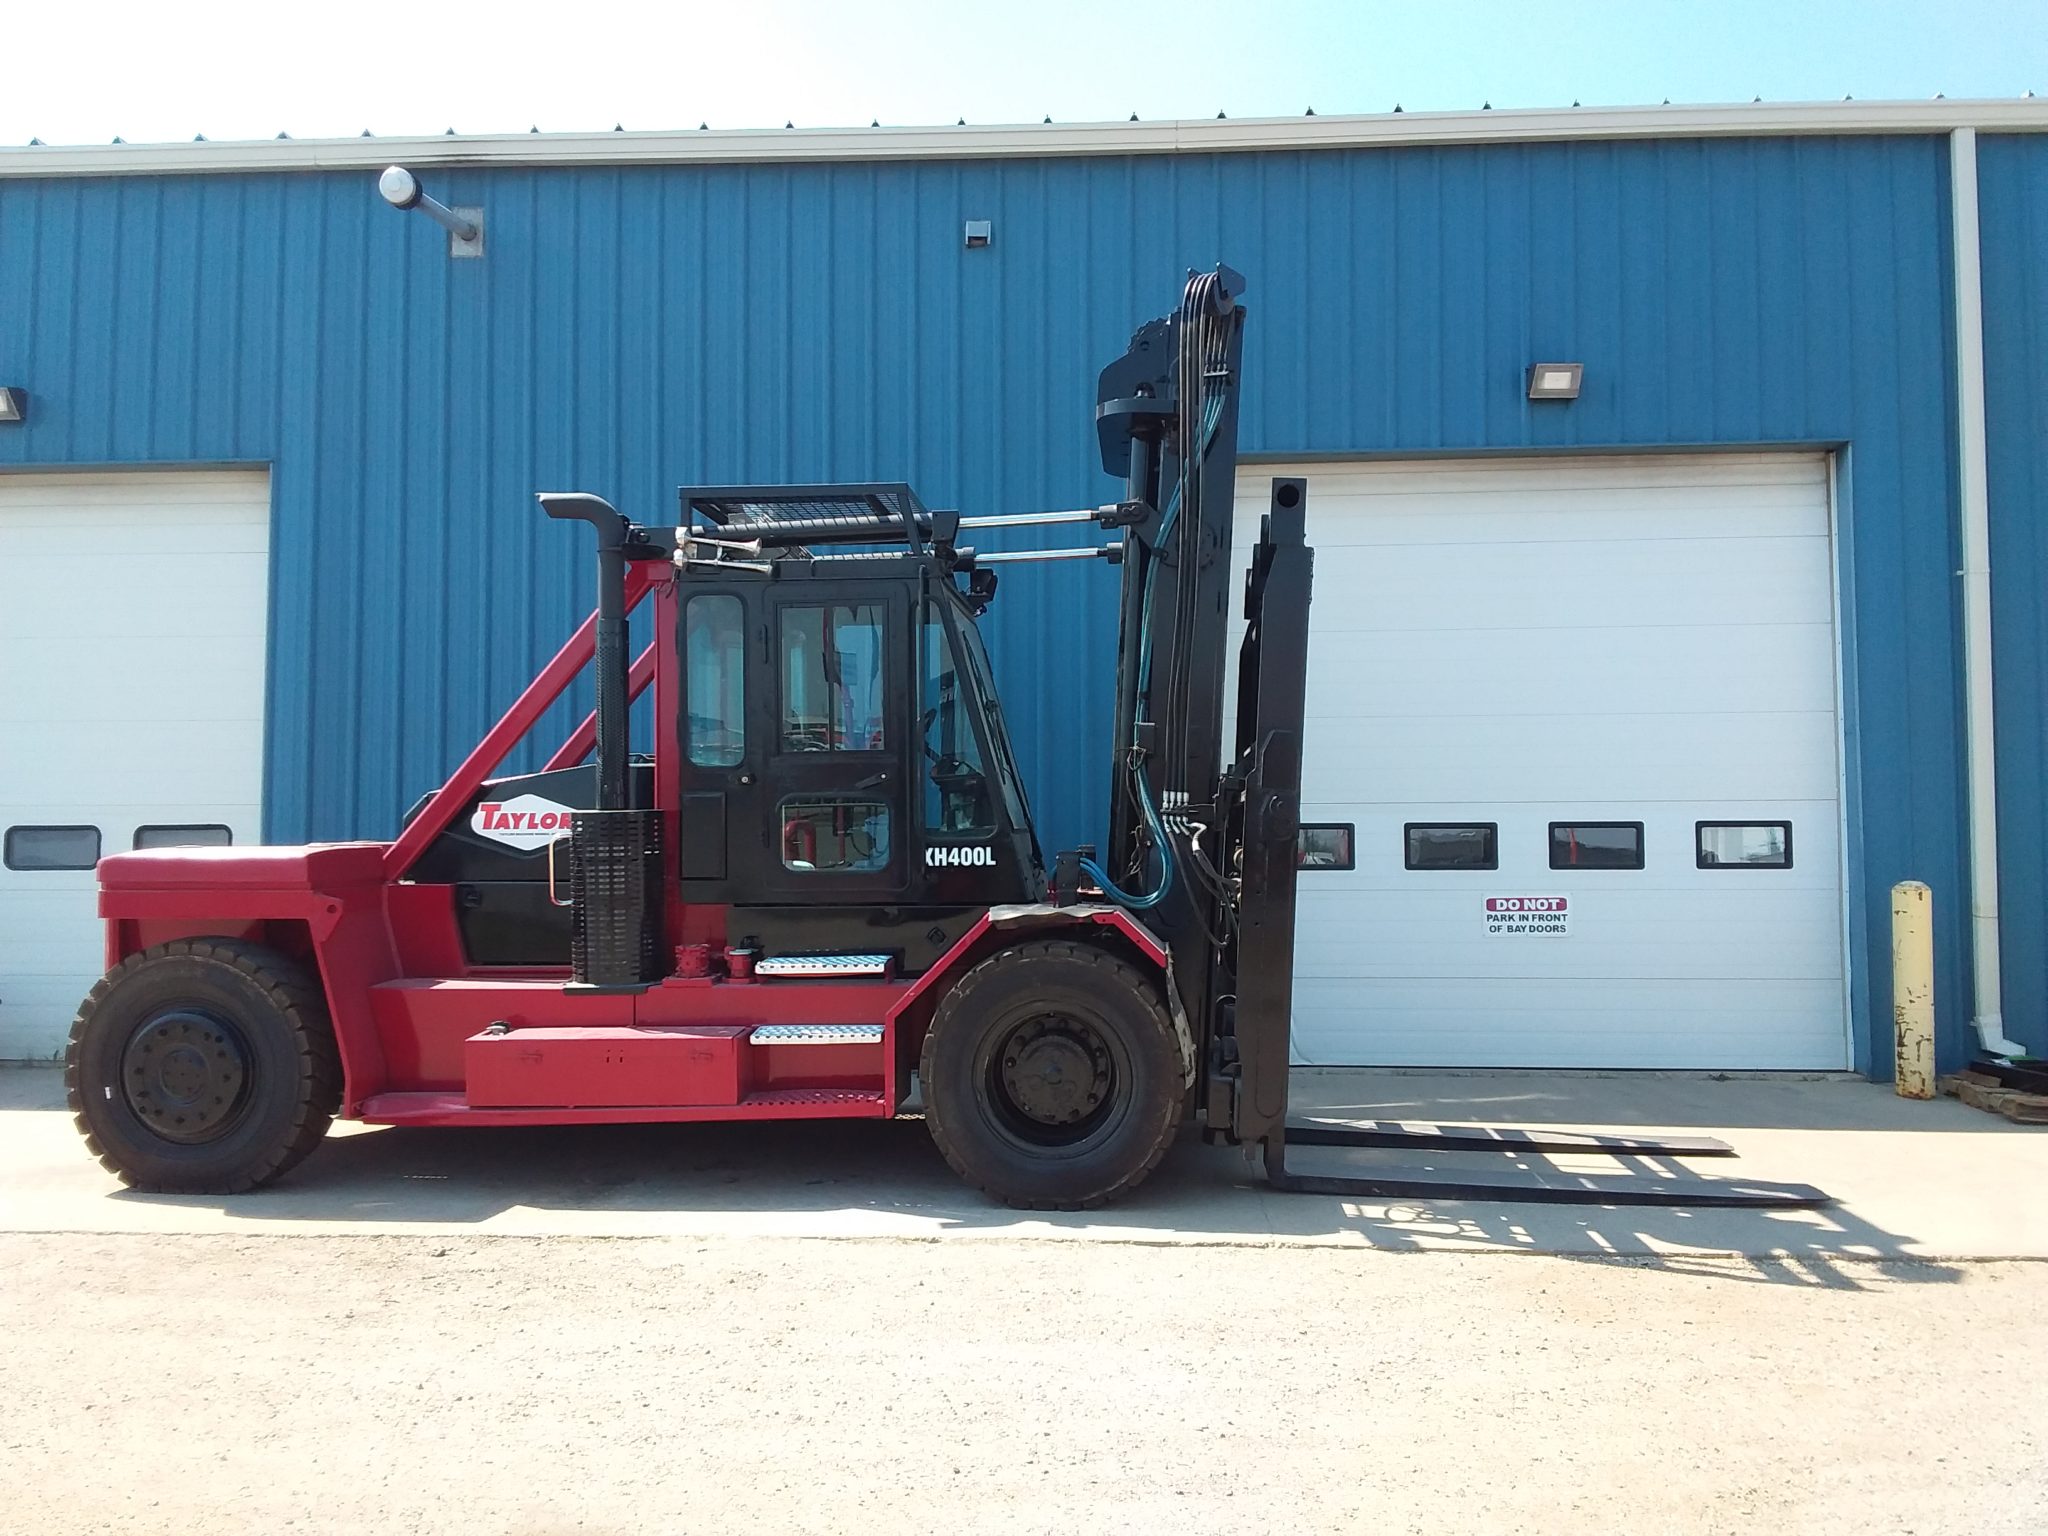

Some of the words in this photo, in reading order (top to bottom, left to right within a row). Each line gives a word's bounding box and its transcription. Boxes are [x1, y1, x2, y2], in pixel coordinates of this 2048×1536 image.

[480, 804, 572, 830] TAYLOR
[1495, 899, 1520, 911] DO
[1523, 898, 1560, 911] NOT
[1486, 913, 1515, 922] PARK
[1518, 913, 1529, 922] IN
[1531, 913, 1568, 922] FRONT
[1489, 924, 1503, 933] OF
[1507, 924, 1527, 933] BAY
[1528, 924, 1567, 933] DOORS
